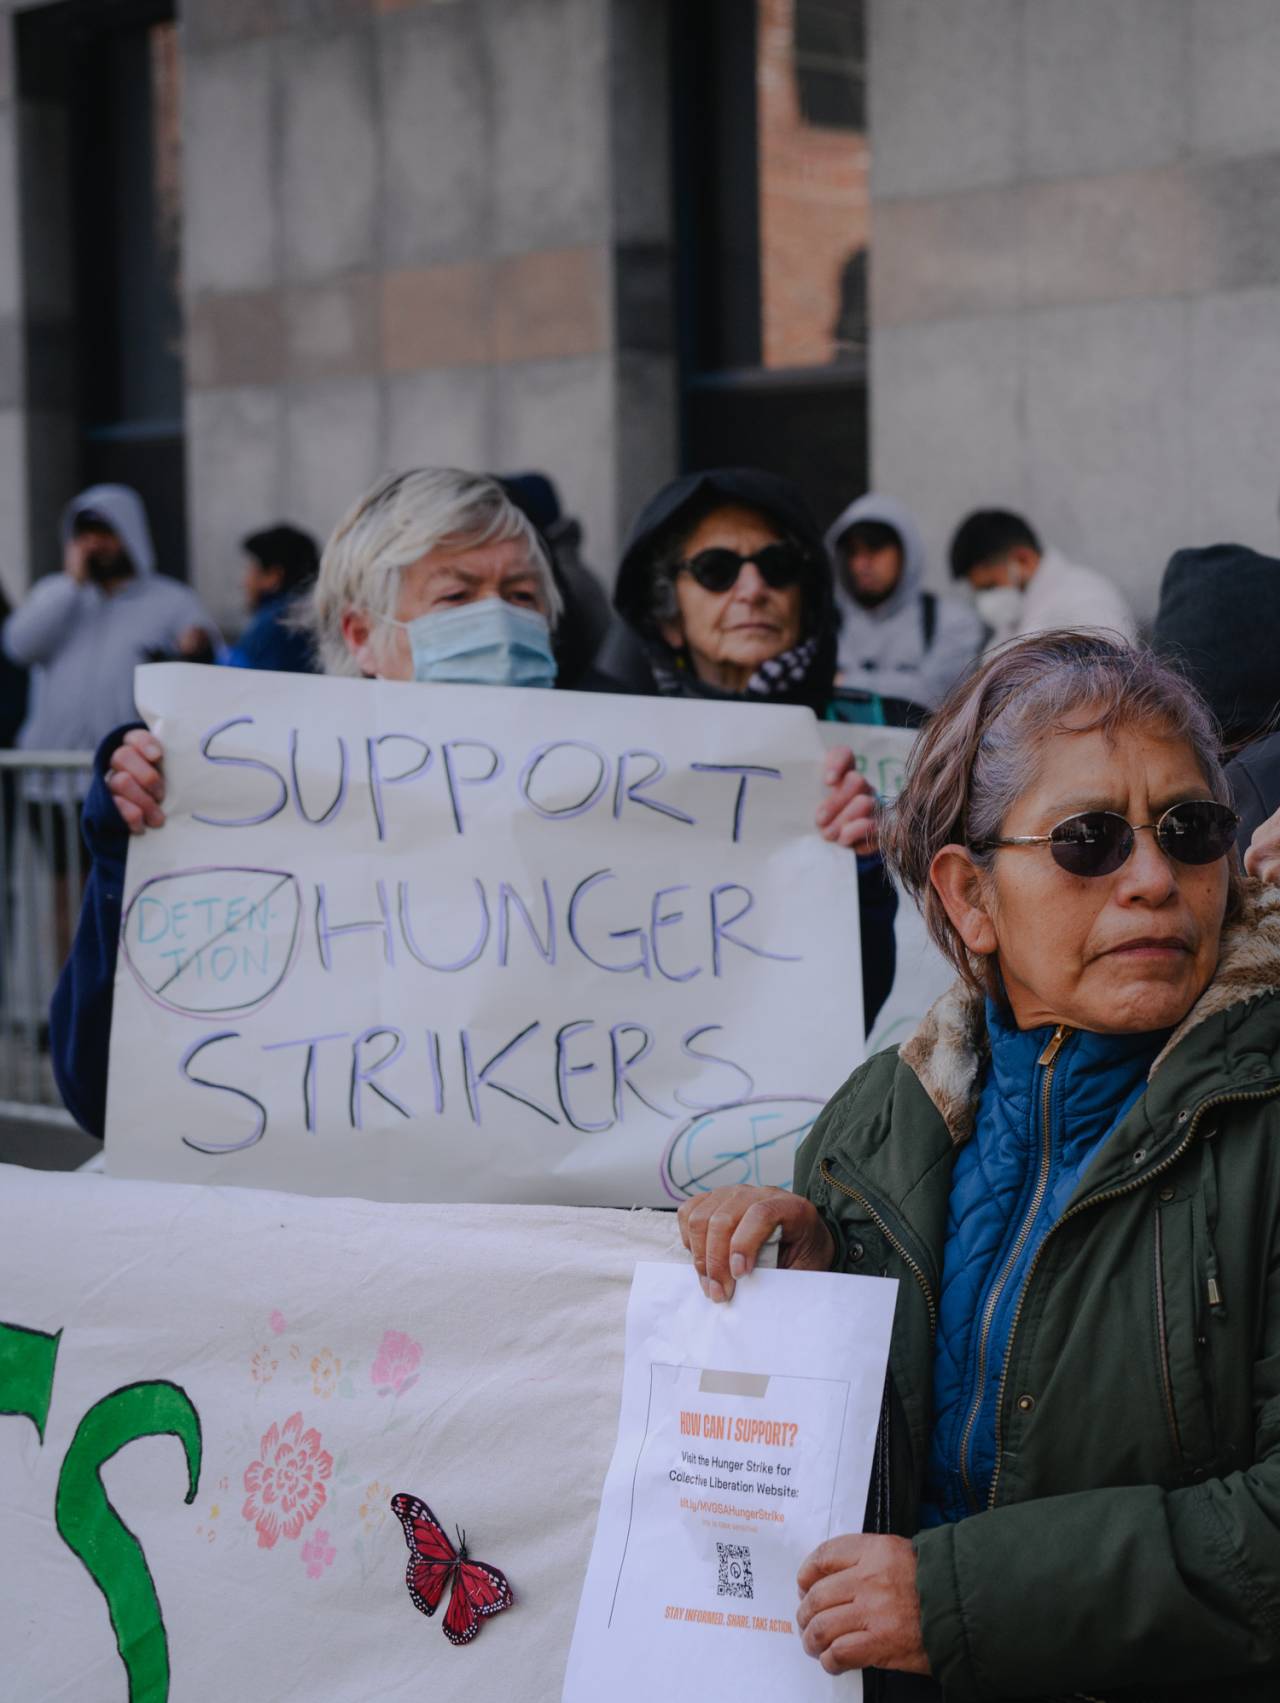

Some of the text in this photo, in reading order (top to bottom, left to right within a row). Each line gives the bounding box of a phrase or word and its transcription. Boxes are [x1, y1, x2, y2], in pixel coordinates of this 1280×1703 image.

[190, 715, 783, 843] SUPPORT
[313, 867, 804, 983] HUNGER
[160, 939, 270, 983] TION
[178, 1019, 755, 1155] STRIKERS
[684, 1112, 818, 1192] GE
[680, 1411, 799, 1448] HOW CAN I SUPPORT?
[698, 1454, 710, 1467] the
[711, 1456, 744, 1473] Hunger
[746, 1459, 774, 1475] Strike
[776, 1463, 792, 1477] for
[709, 1476, 755, 1494] Liberation
[756, 1482, 800, 1499] Website:
[665, 1606, 684, 1621] STAY
